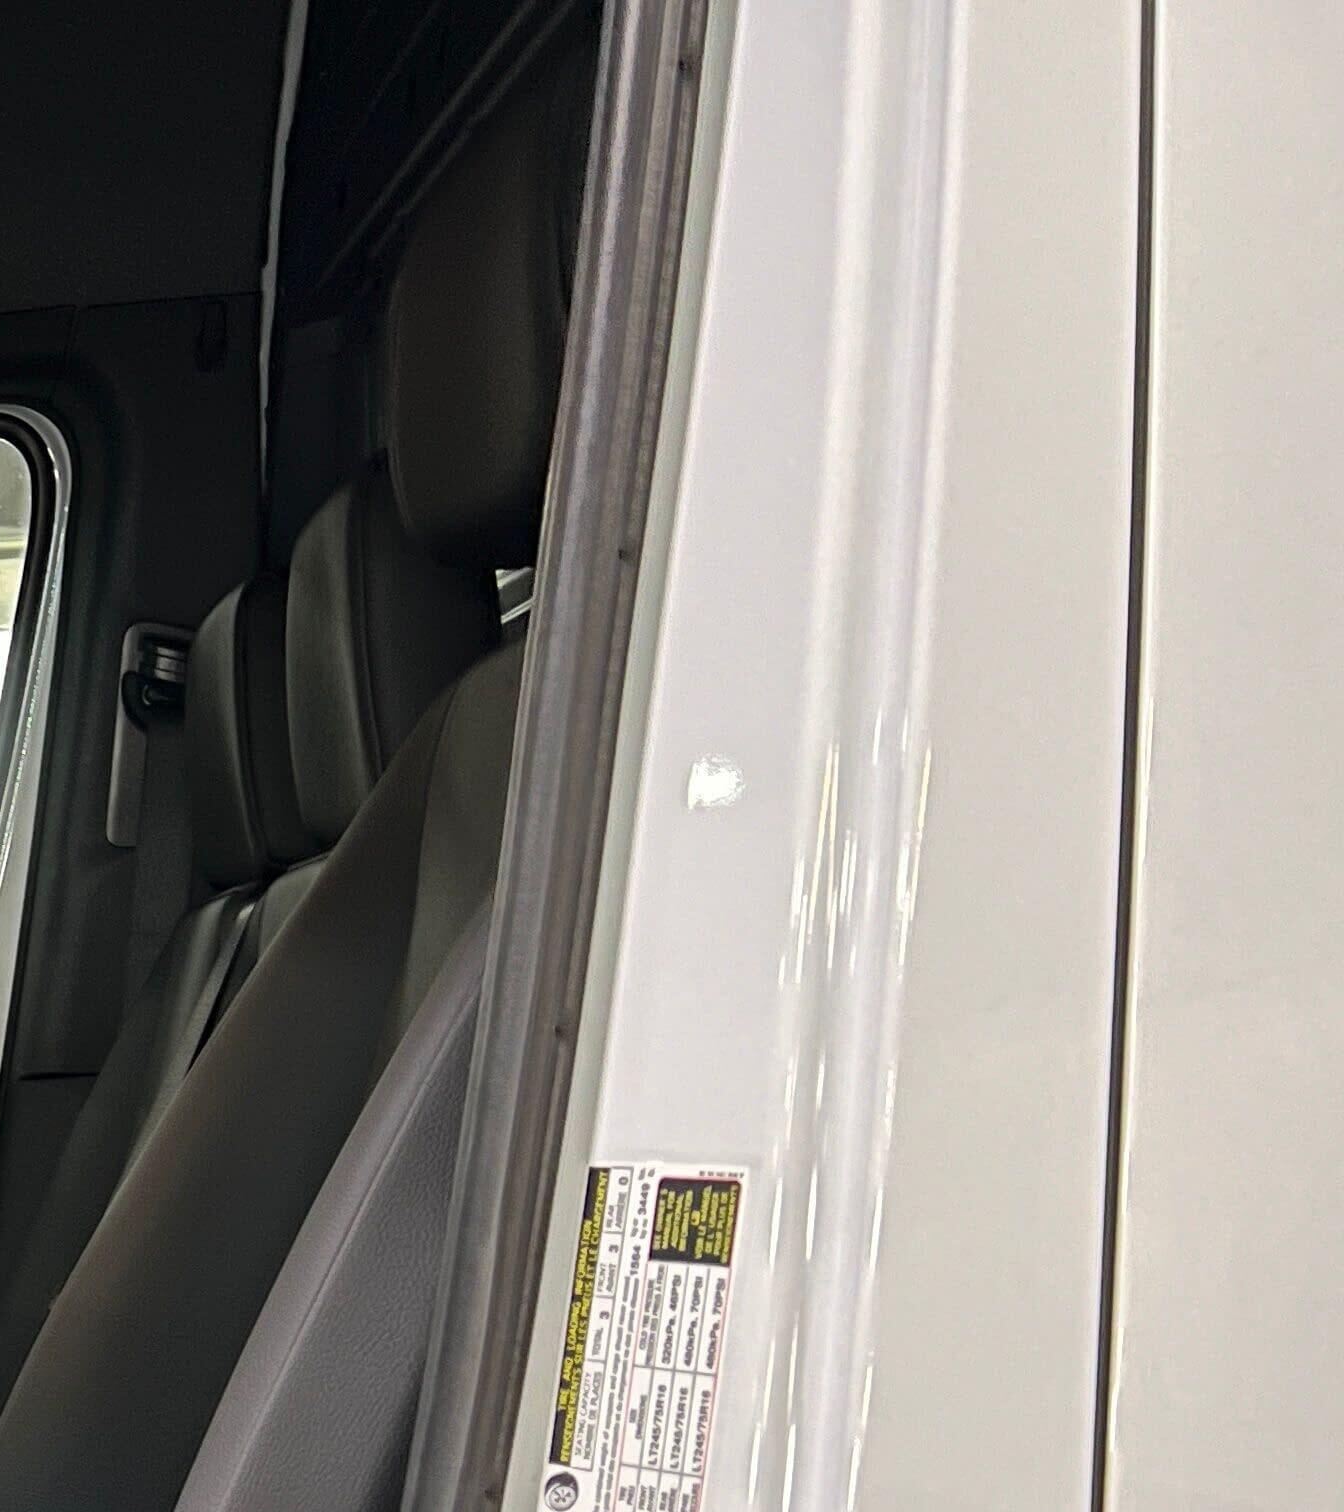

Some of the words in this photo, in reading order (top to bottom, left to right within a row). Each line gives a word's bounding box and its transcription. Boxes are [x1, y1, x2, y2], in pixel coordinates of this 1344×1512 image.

[617, 1175, 629, 1185] 0
[636, 1182, 651, 1215] 3449
[573, 1219, 594, 1296] INFORMATION
[608, 1243, 619, 1253] 3
[596, 1261, 606, 1291] FRONT
[565, 1300, 582, 1350] LOADING
[590, 1326, 604, 1355] TOTAL
[598, 1310, 610, 1320] 3
[561, 1355, 574, 1381] AND
[556, 1388, 569, 1411] TIRE
[579, 1371, 593, 1416] CAPACITY
[573, 1418, 586, 1456] SEATING
